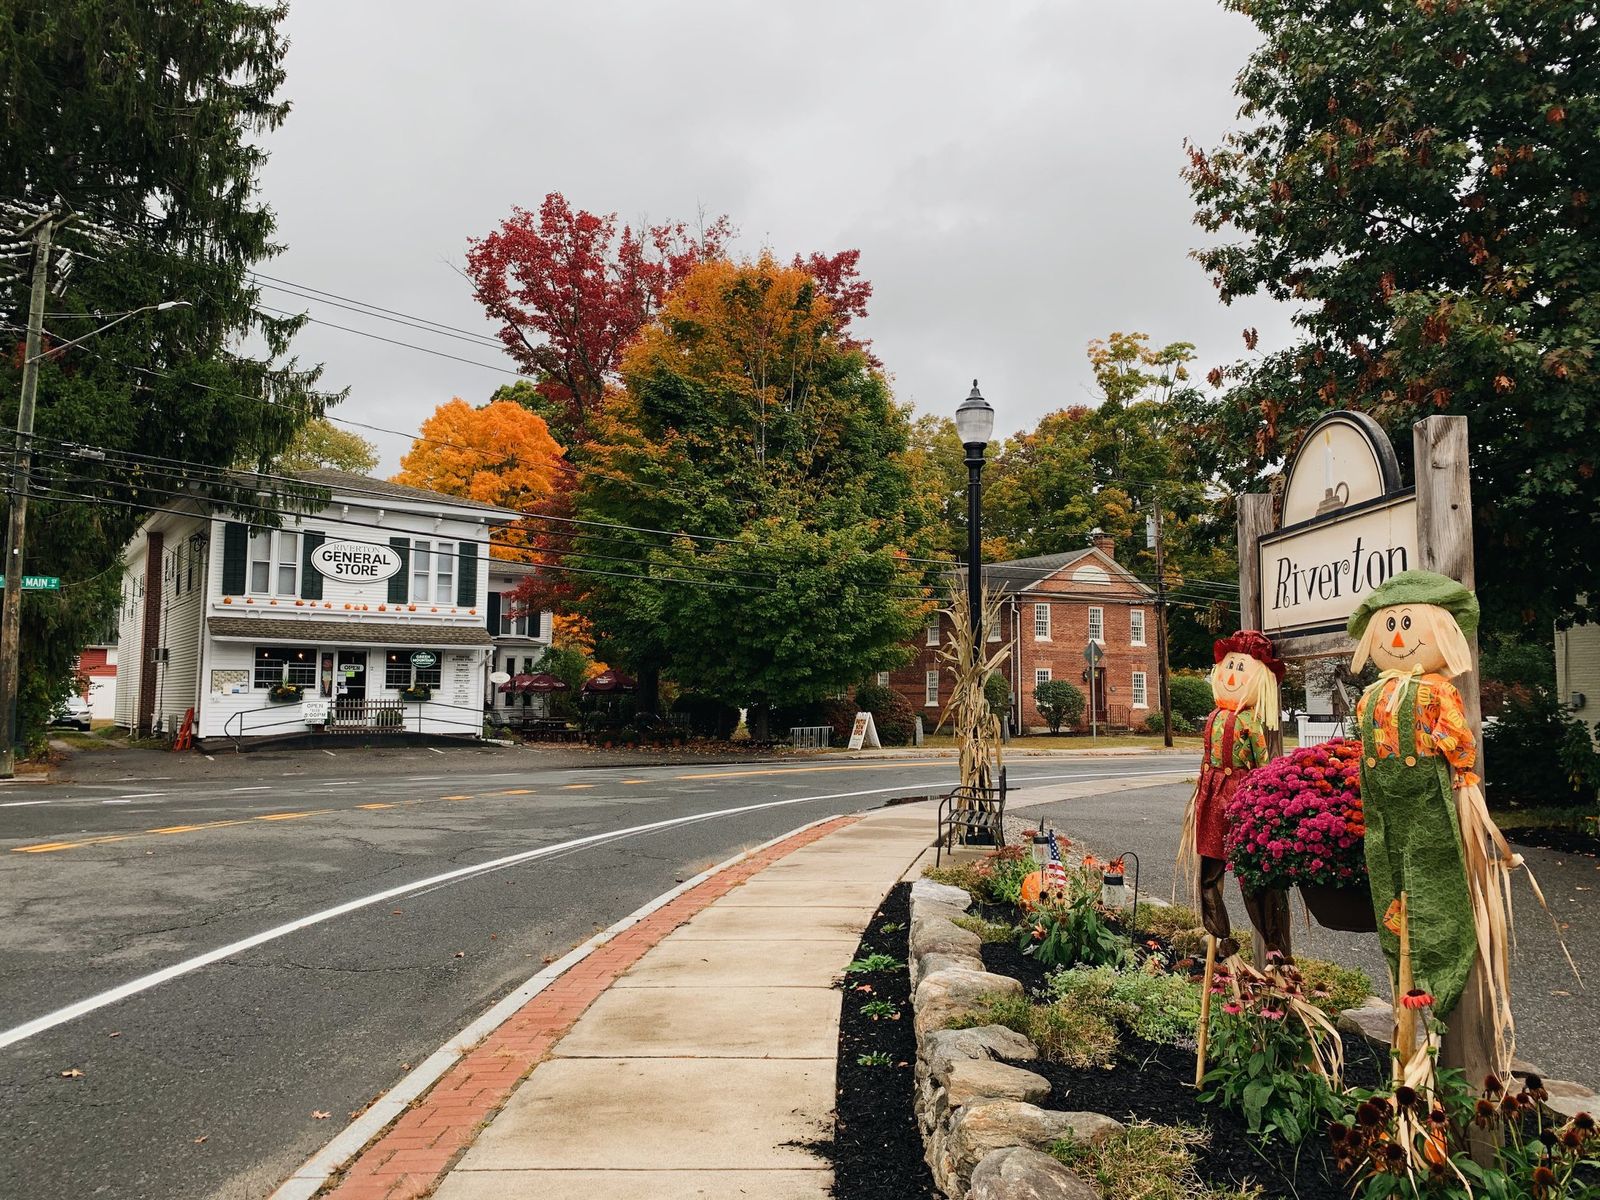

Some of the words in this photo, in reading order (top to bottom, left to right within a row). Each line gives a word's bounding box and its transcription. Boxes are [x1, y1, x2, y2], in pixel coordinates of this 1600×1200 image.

[333, 543, 381, 554] RIVERTON
[322, 550, 391, 566] GENERAL
[335, 563, 378, 577] STORE
[1272, 537, 1408, 610] Riverton
[25, 577, 48, 588] MAIN
